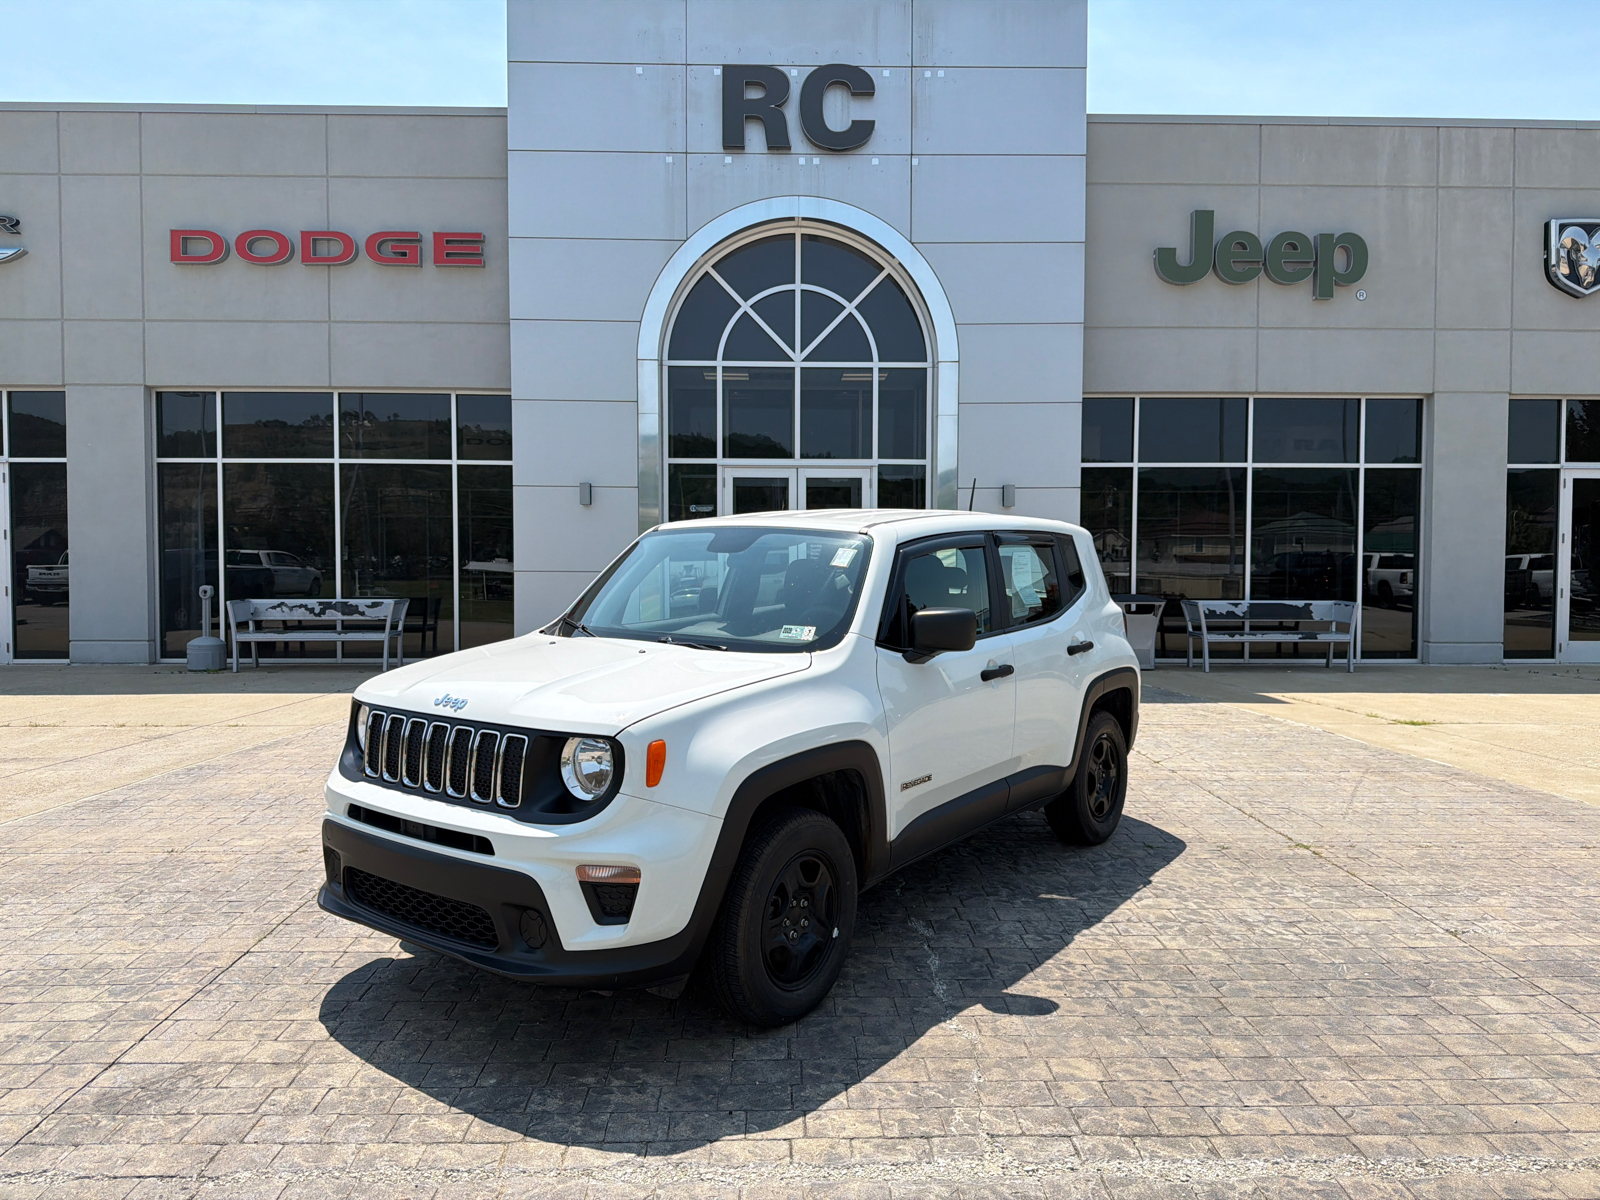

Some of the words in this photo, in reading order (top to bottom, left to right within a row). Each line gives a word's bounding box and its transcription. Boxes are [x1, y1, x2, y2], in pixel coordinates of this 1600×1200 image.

[722, 63, 876, 153] RC
[169, 229, 485, 267] DODGE
[1153, 209, 1368, 300] Jeep
[434, 693, 469, 713] Jeep
[900, 773, 933, 792] RENEGADE
